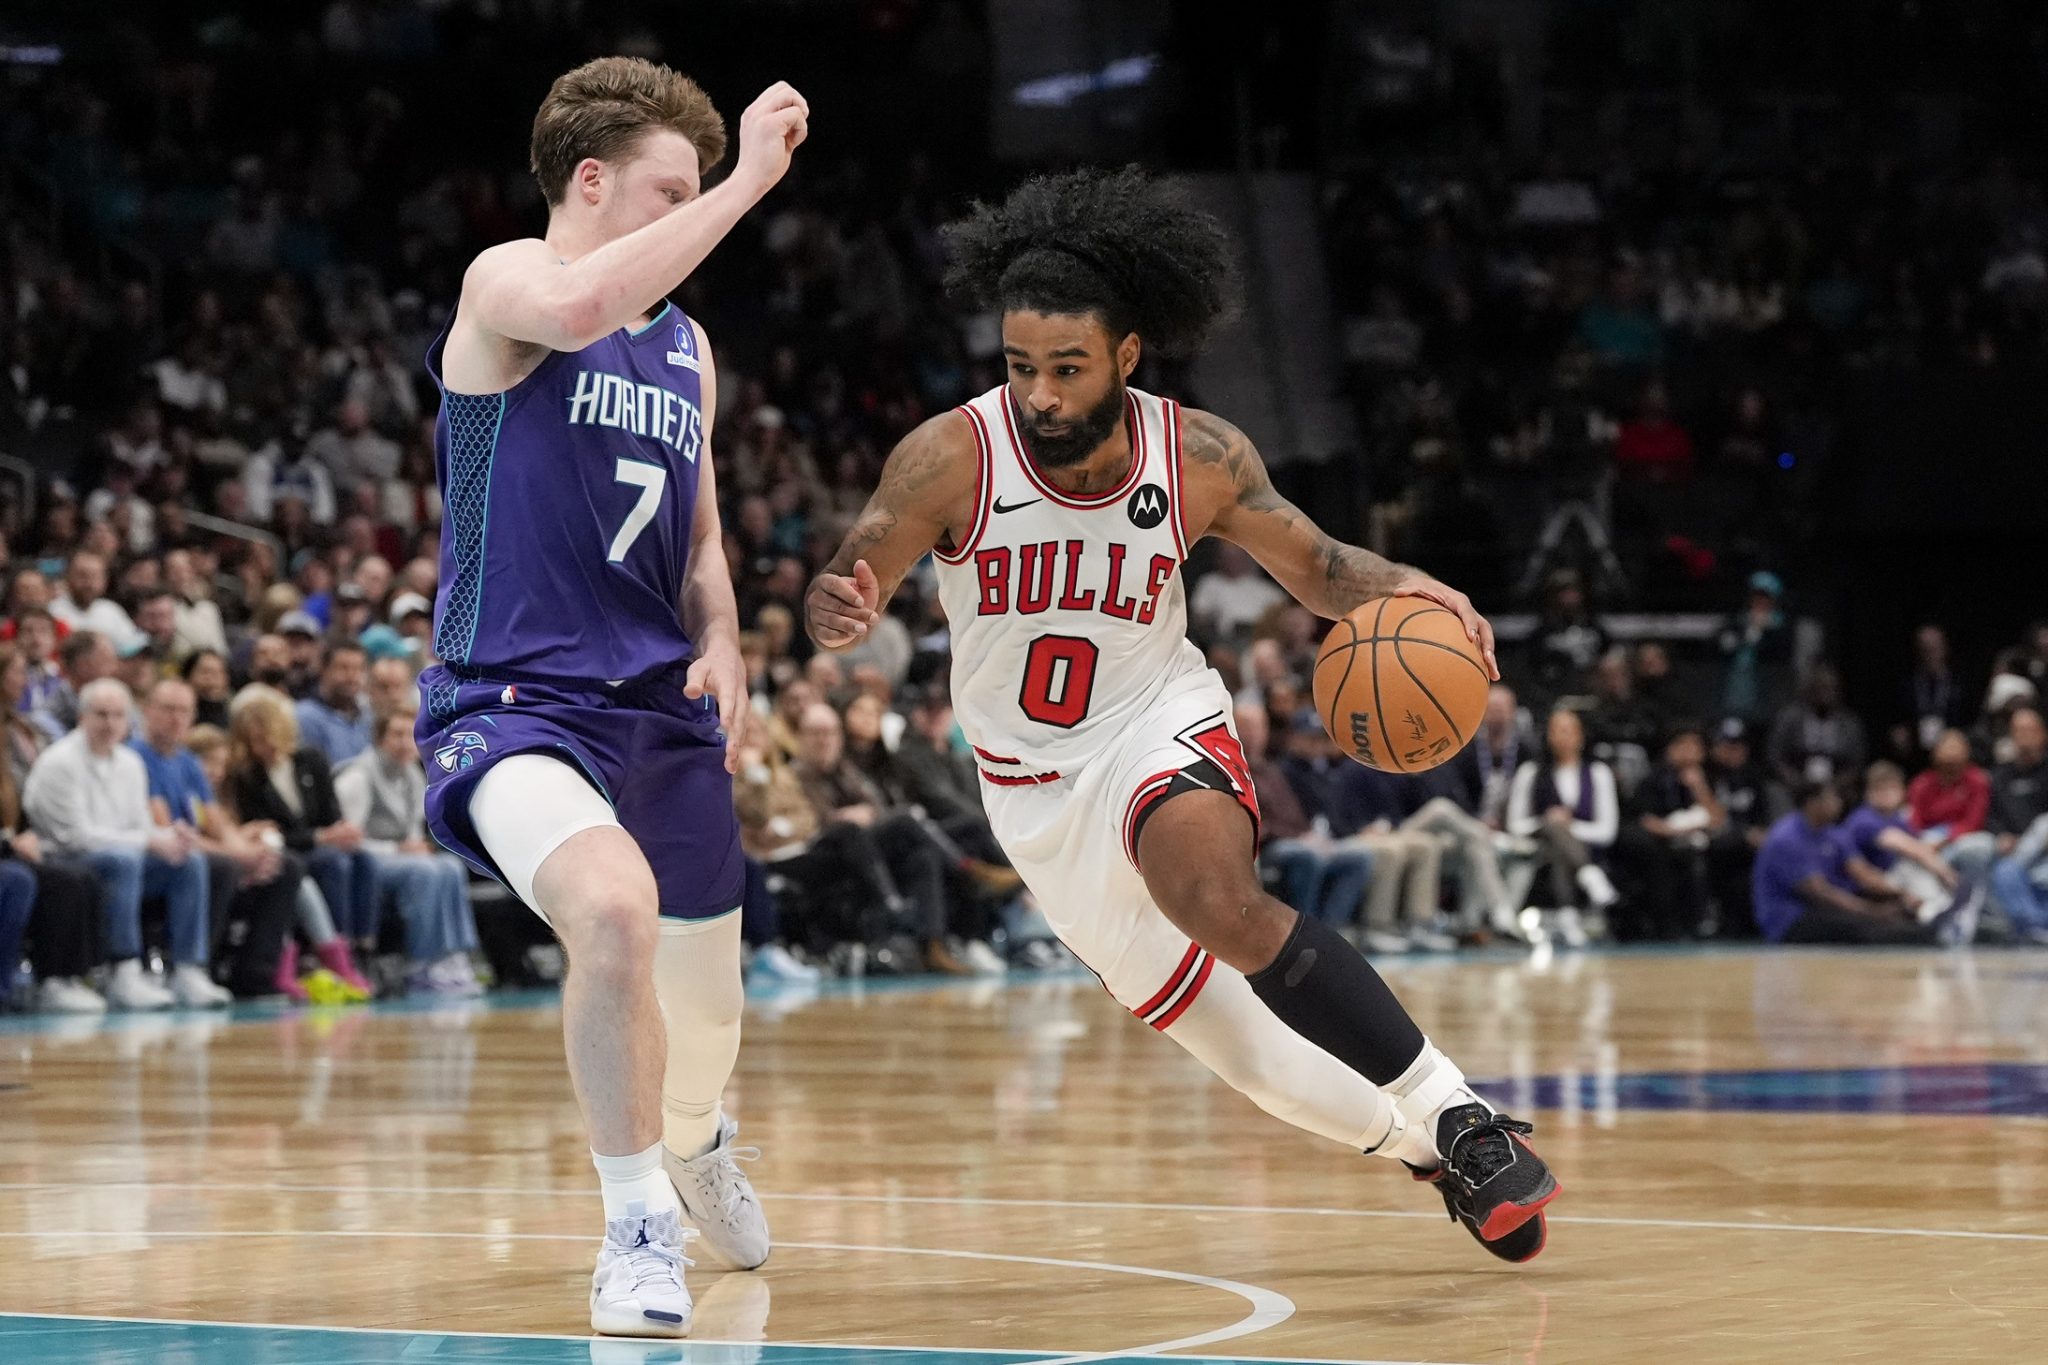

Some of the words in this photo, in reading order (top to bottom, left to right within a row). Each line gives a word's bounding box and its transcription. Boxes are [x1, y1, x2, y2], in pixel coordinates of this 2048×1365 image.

[567, 371, 703, 464] HORNETS
[607, 456, 667, 563] 7
[974, 539, 1176, 625] BULLS
[1018, 634, 1099, 729] 0
